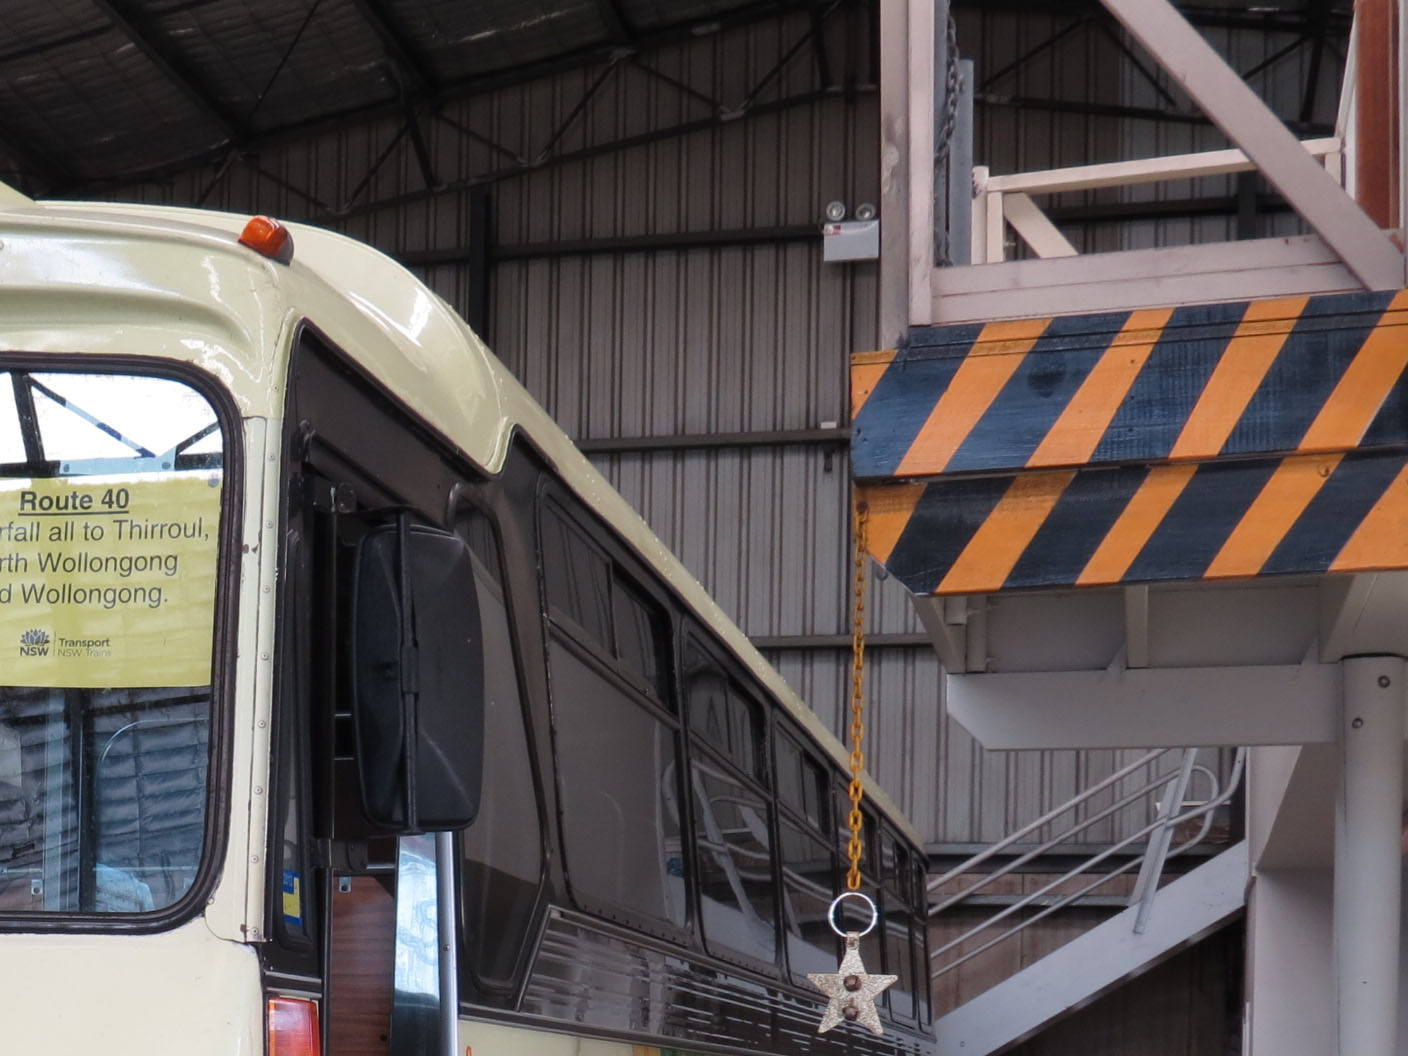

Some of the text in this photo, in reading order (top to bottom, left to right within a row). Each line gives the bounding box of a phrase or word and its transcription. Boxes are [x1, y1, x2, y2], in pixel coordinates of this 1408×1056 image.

[18, 488, 130, 512] Route 40
[48, 520, 75, 542] all
[82, 522, 105, 541] to
[113, 517, 209, 543] Thirroul,
[37, 551, 178, 577] Wollongong
[21, 583, 169, 609] Wollongong.
[19, 645, 49, 657] NSW
[58, 637, 111, 649] Transport
